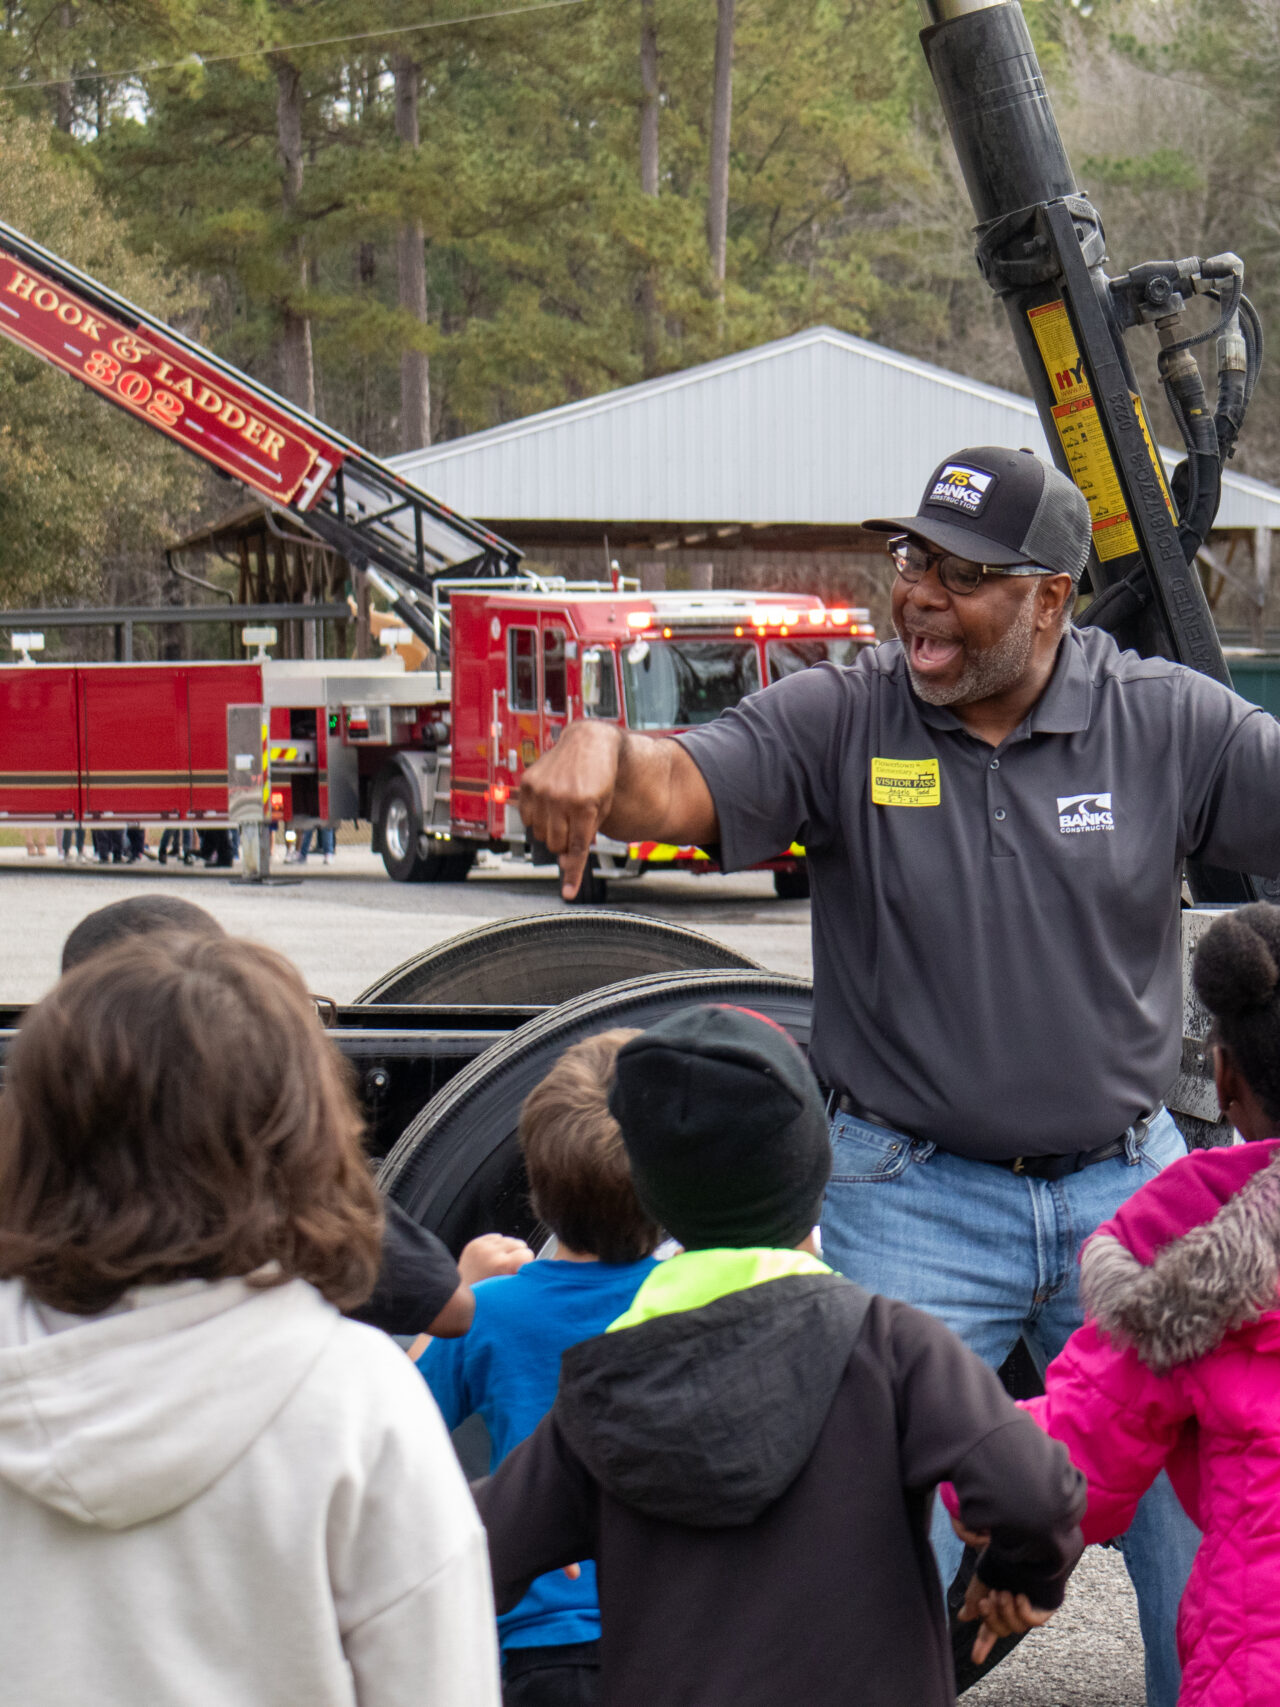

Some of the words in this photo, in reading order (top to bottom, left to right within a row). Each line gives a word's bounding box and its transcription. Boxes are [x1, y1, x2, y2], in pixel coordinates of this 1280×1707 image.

[6, 270, 107, 341] HOOK
[109, 335, 150, 363] &
[154, 360, 286, 461] LADDER
[949, 470, 970, 486] 75
[932, 482, 982, 505] BANKS
[930, 494, 977, 511] CONSTRUCTION
[876, 777, 911, 787] VISITOR
[914, 779, 936, 787] PASS
[1059, 811, 1114, 828] BANKS
[1060, 824, 1115, 834] CONSTRUCTION
